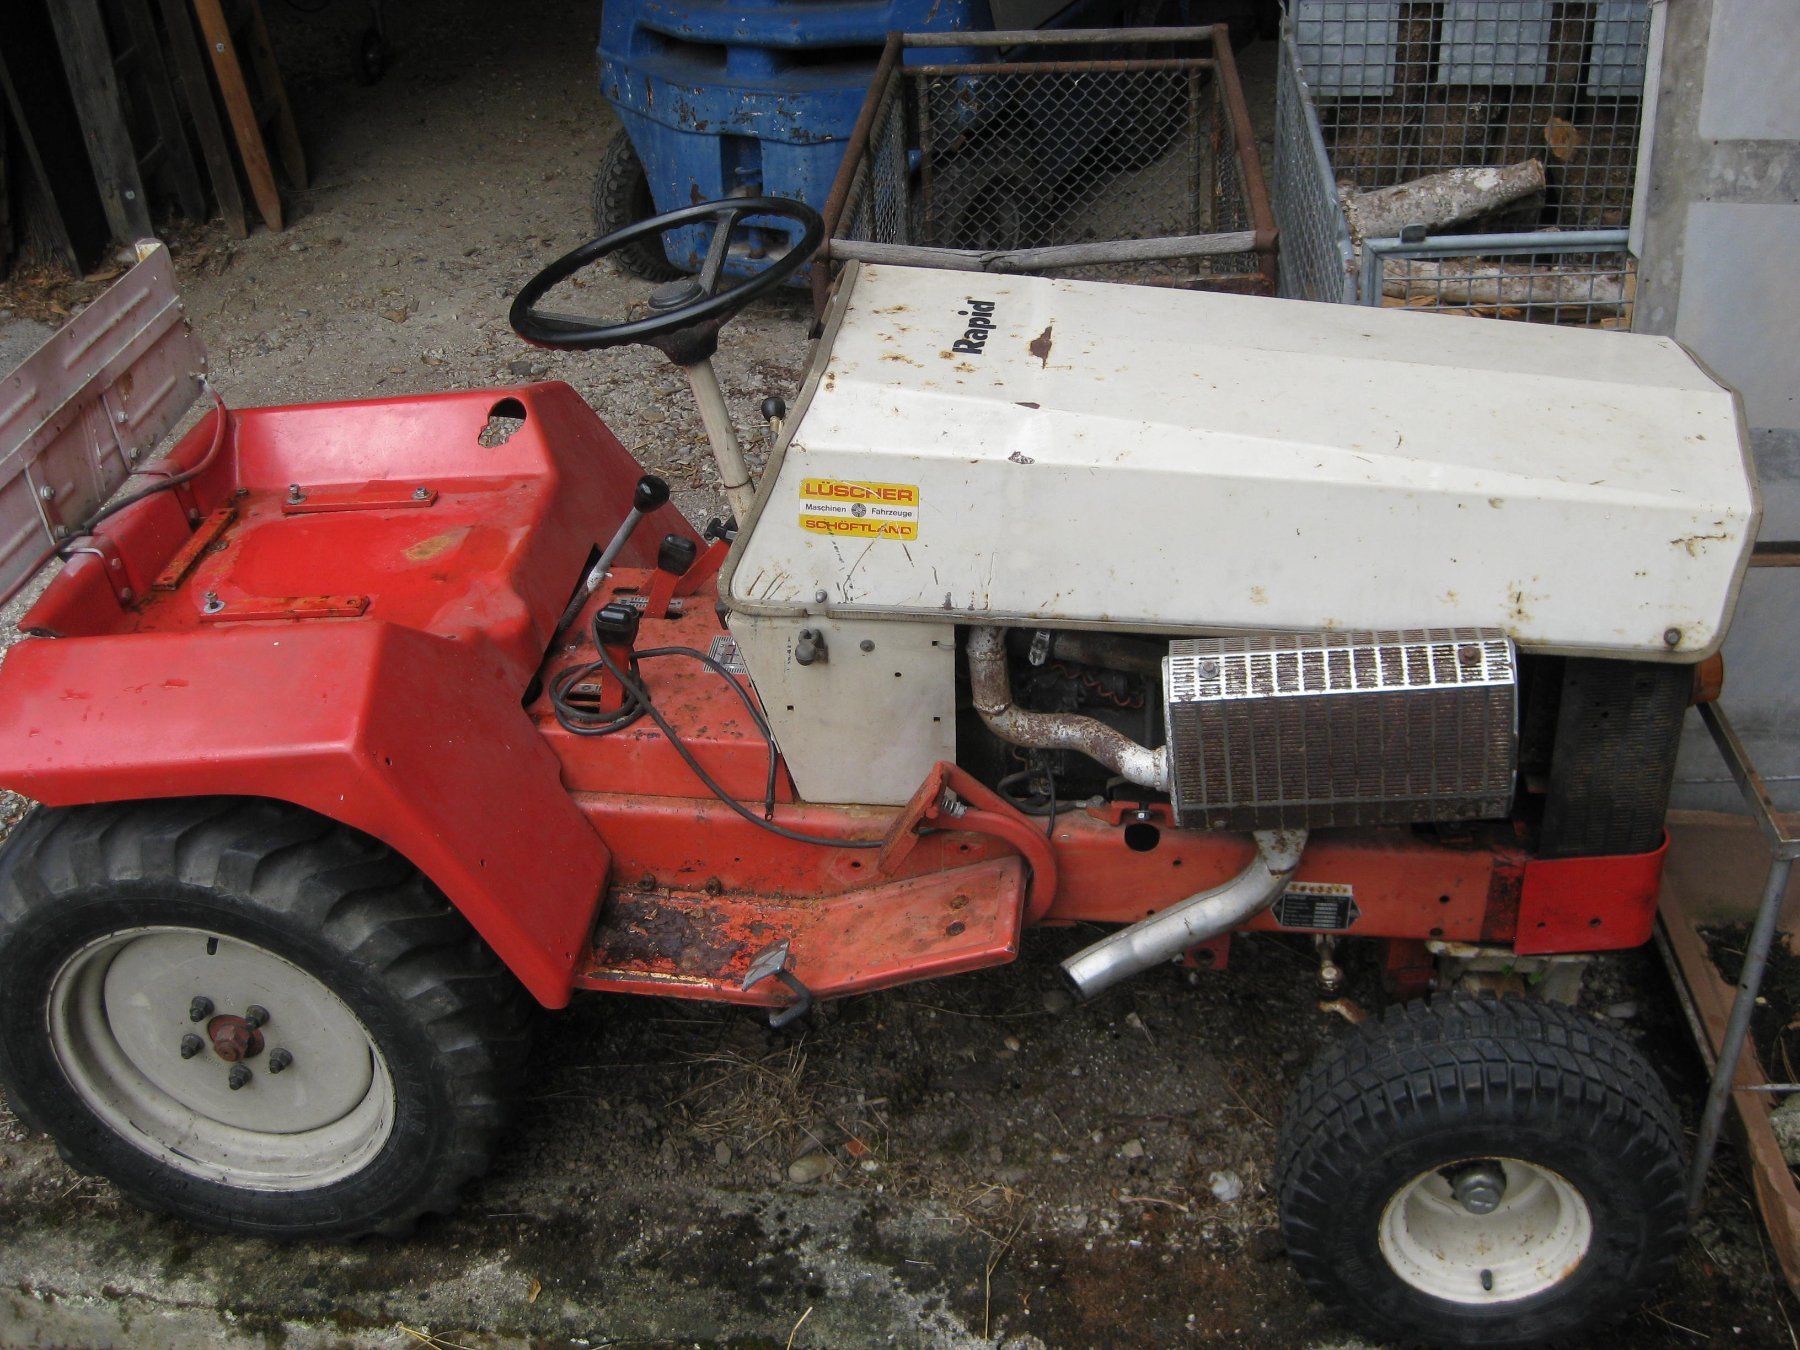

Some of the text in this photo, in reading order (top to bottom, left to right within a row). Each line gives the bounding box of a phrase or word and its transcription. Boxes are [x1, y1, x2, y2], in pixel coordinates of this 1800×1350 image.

[952, 300, 997, 354] Rapid
[805, 481, 913, 501] LÜSCHER
[805, 503, 912, 517] Maschinen Fahrzeuge
[805, 519, 912, 535] SCHÖFTLAND
